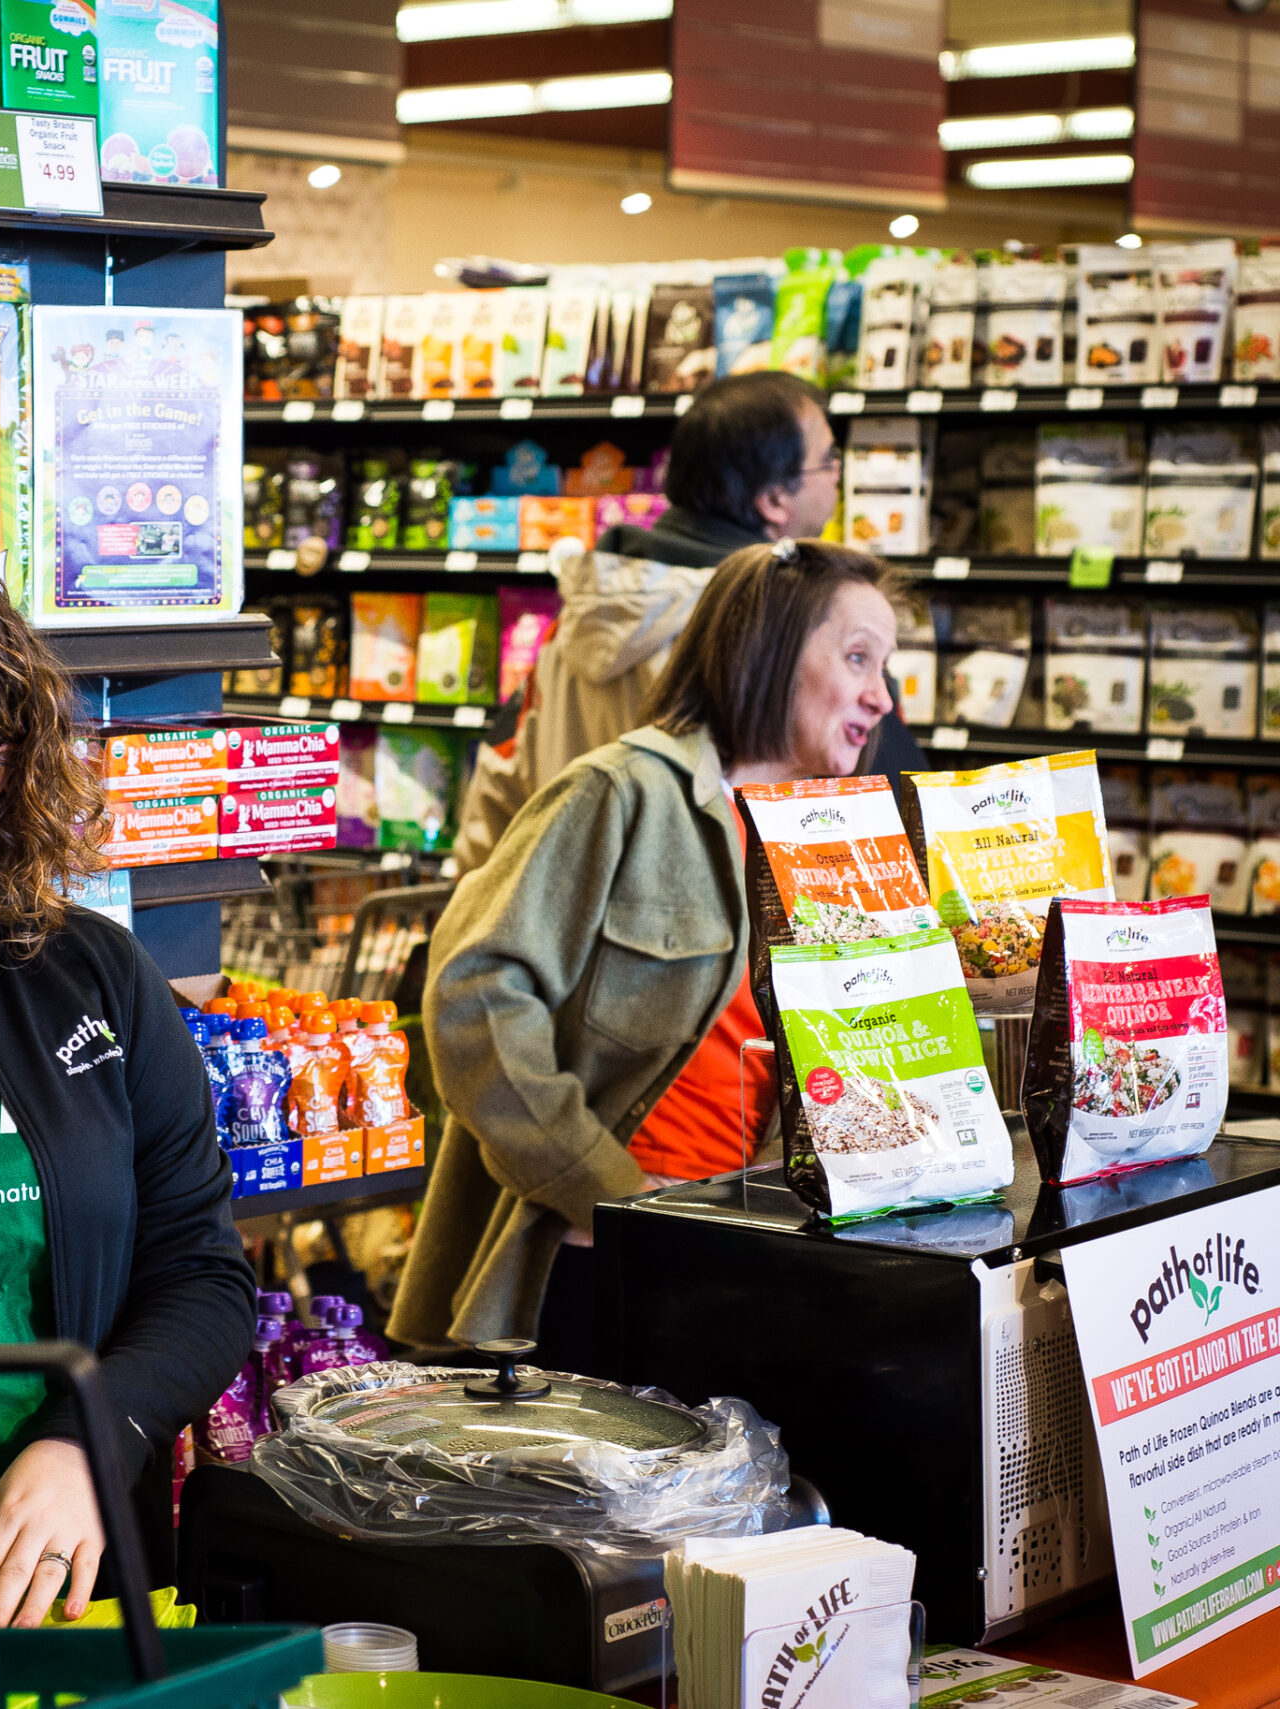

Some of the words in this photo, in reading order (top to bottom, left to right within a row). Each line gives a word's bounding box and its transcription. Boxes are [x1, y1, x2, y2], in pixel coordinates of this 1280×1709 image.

[9, 32, 46, 46] ORGANIC
[10, 43, 69, 73] FRUIT
[35, 70, 65, 82] SNACKS
[103, 57, 177, 84] FRUIT
[29, 128, 58, 141] Organic
[60, 131, 78, 141] Fruit
[31, 117, 51, 129] Tasty
[53, 120, 75, 130] Brand
[42, 140, 66, 150] Snack
[77, 372, 116, 388] STAR
[154, 374, 198, 390] WEEK
[77, 408, 102, 425] Get
[106, 404, 121, 418] in
[126, 402, 151, 417] the
[154, 402, 203, 426] Game!
[149, 730, 198, 742] ORGANIC
[264, 725, 311, 736] ORGANIC
[136, 797, 186, 809] ORGANIC
[260, 789, 307, 800] ORGANIC
[971, 792, 999, 814] path
[1000, 790, 1009, 800] of
[1011, 789, 1031, 804] life
[800, 808, 820, 829] path
[820, 809, 828, 818] of
[828, 808, 846, 824] life
[975, 837, 991, 849] All
[996, 830, 1039, 847] Natural
[816, 851, 854, 867] Organic
[791, 866, 841, 887] QUINOA
[841, 866, 859, 882] &
[978, 862, 1056, 894] QUINOA
[1129, 927, 1149, 943] life
[843, 969, 865, 992] path
[1119, 968, 1158, 983] Natural
[1081, 975, 1210, 1003] MEDITERRANEAN
[849, 1012, 897, 1030] Organic
[1107, 1001, 1172, 1029] QUINOA
[56, 1015, 104, 1066] path
[838, 1023, 910, 1051] QUINOA
[911, 1019, 931, 1039] &
[829, 1047, 896, 1068] BROWN
[898, 1035, 952, 1063] RICE
[264, 1157, 283, 1167] CHIA
[1130, 1245, 1191, 1344] path
[1193, 1238, 1212, 1276] of
[1216, 1232, 1259, 1295] life
[1110, 1366, 1157, 1412] WE'VE
[1155, 1355, 1182, 1395] GOT
[1181, 1337, 1229, 1384] FLAVOR
[1227, 1331, 1242, 1365] IN
[1241, 1321, 1267, 1358] THE
[1119, 1445, 1141, 1466] Path
[1142, 1438, 1151, 1456] of
[1152, 1433, 1168, 1452] Life
[1169, 1422, 1198, 1444] Frozen
[1199, 1408, 1230, 1430] Quinoa
[1230, 1394, 1257, 1417] Blends
[1258, 1389, 1273, 1404] are
[1129, 1460, 1167, 1488] flavorful
[1167, 1452, 1185, 1472] side
[1186, 1443, 1205, 1462] dish
[1206, 1435, 1221, 1454] that
[1223, 1431, 1237, 1447] are
[1237, 1418, 1261, 1441] ready
[1261, 1414, 1271, 1428] in
[1160, 1488, 1202, 1514] Convenient,
[1202, 1462, 1252, 1493] microwaveable
[1252, 1453, 1273, 1471] steam
[1164, 1510, 1203, 1538] Organic/All
[1203, 1497, 1227, 1519] Natural
[1167, 1542, 1189, 1562] Good
[1188, 1531, 1212, 1552] Source
[1212, 1527, 1220, 1542] of
[1220, 1513, 1242, 1536] Protein
[1242, 1512, 1249, 1525] &
[1249, 1507, 1262, 1522] Iron
[1170, 1561, 1201, 1586] Naturally
[1201, 1545, 1236, 1574] gluten-free
[794, 1623, 810, 1645] OF
[806, 1577, 854, 1632] LIFE
[1151, 1568, 1265, 1648] WWW.PATHOFLIFEBRAND.COM
[609, 1610, 662, 1638] CROCK-POT
[927, 1659, 994, 1671] life
